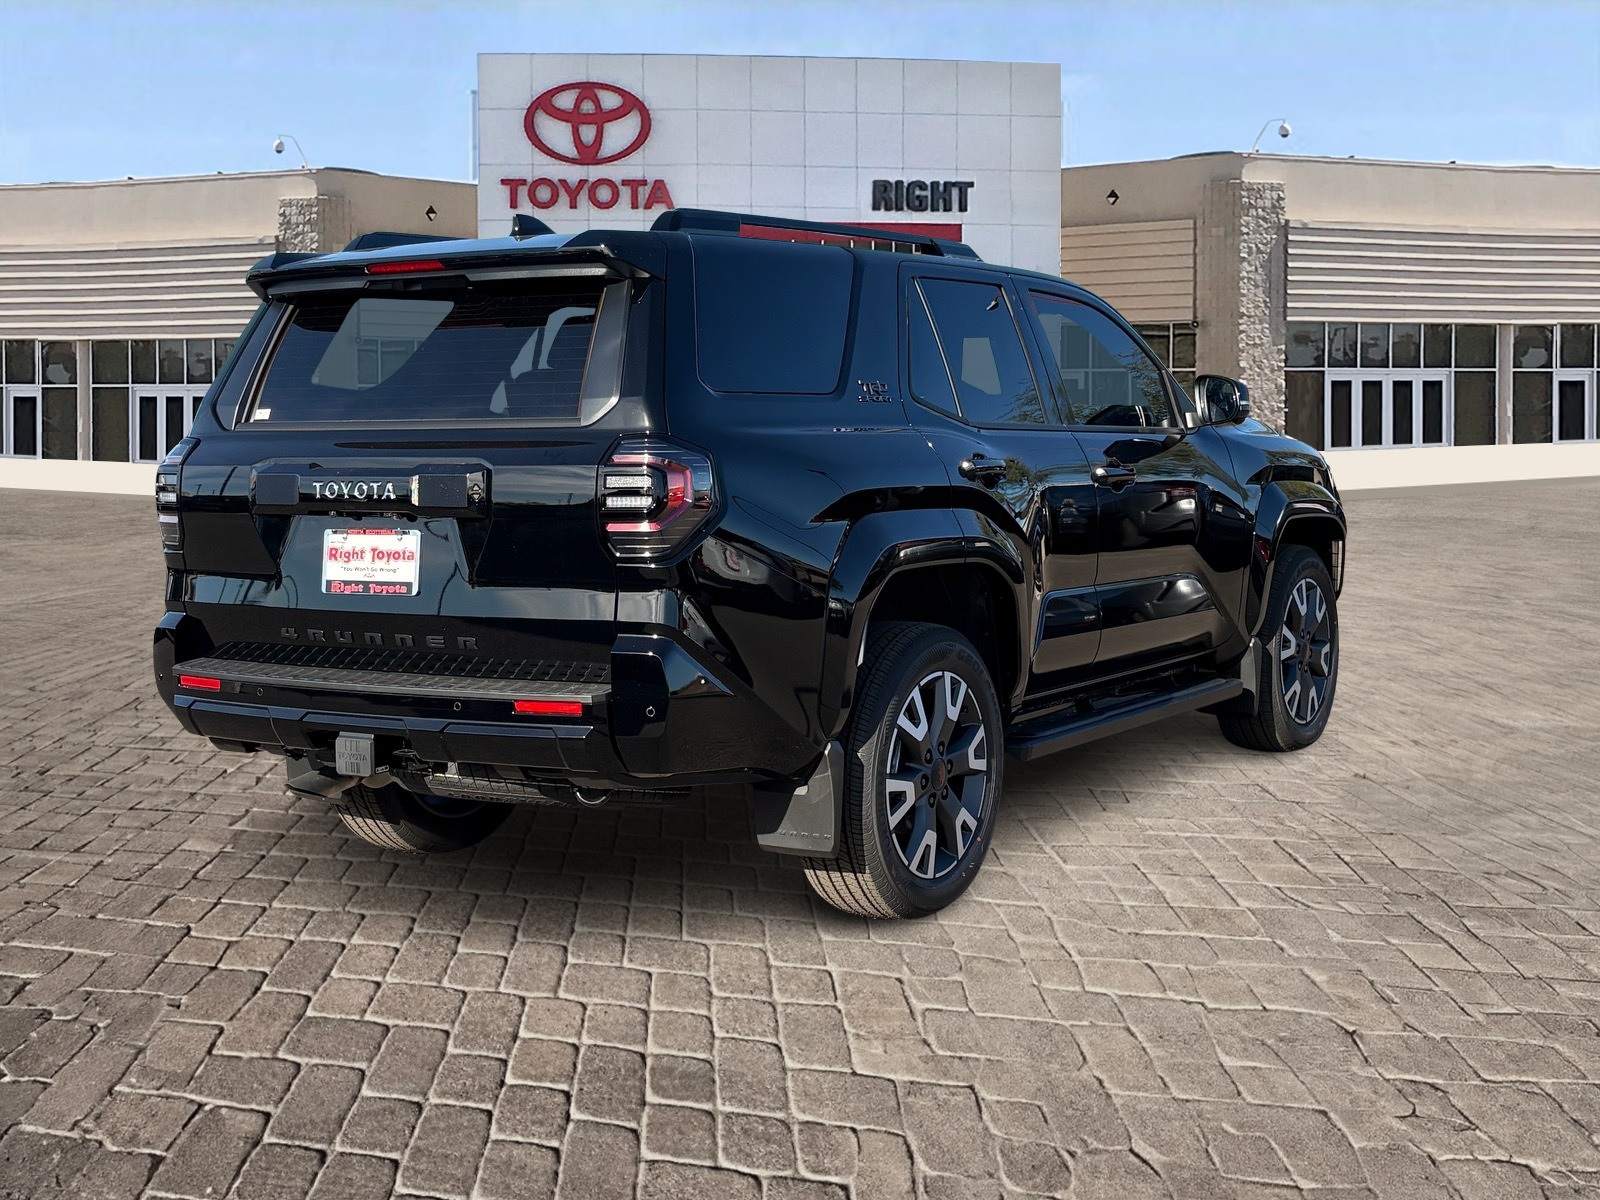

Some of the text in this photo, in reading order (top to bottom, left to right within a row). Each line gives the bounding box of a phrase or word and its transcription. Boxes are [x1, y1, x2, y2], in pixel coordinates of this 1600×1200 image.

[501, 179, 675, 209] TOYOTA
[871, 179, 975, 213] RIGHT
[313, 481, 396, 499] TOYOTA
[329, 546, 415, 563] Right Toyota
[331, 581, 407, 594] Right Toyota
[280, 627, 480, 650] 4RUNNER
[338, 752, 368, 761] TOYOTA
